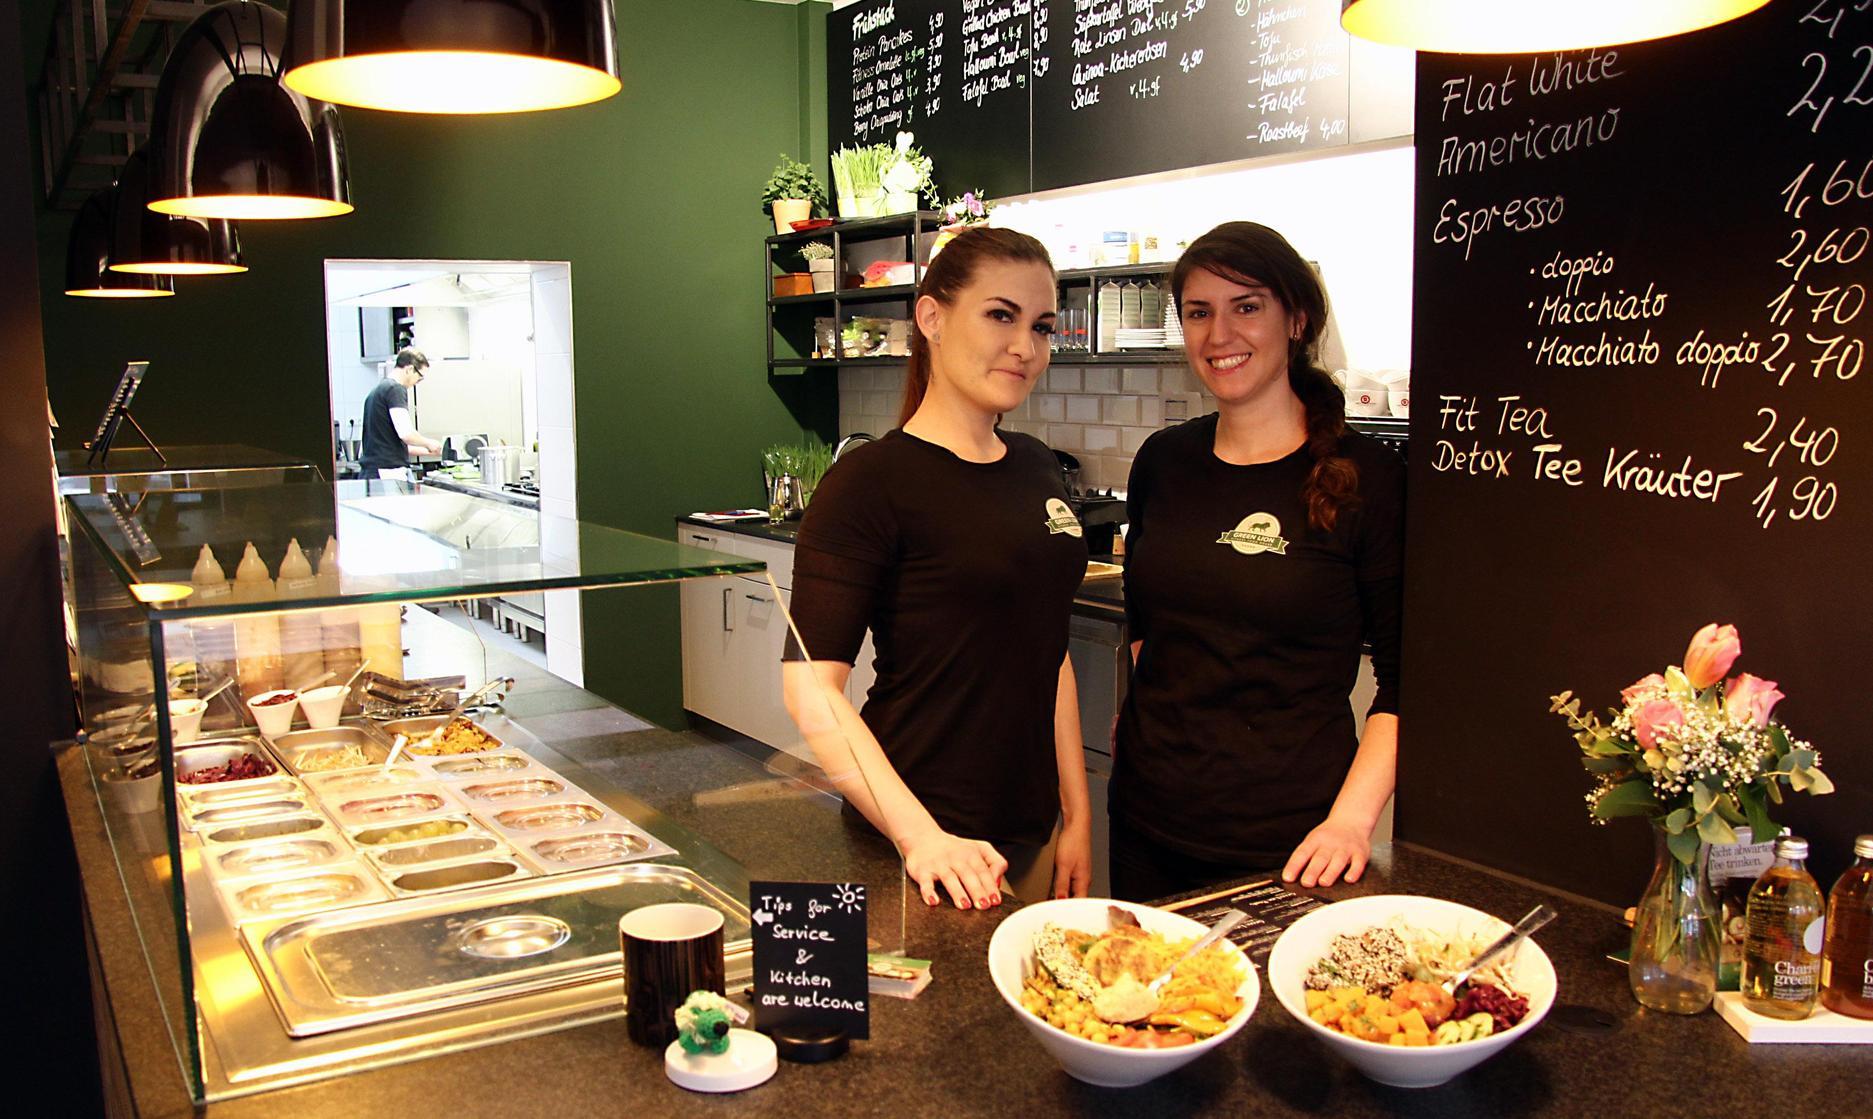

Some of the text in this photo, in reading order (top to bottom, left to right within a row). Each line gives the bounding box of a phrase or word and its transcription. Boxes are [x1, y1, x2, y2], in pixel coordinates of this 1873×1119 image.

[986, 7, 1011, 28] Chicken
[981, 27, 999, 48] Bowl
[1071, 38, 1092, 58] Rote
[1095, 27, 1126, 48] Linsen
[1258, 32, 1281, 53] Tofu
[1179, 48, 1204, 73] 4,90
[962, 77, 989, 108] Falafel
[1070, 84, 1100, 110] Salat
[1442, 48, 1626, 122] Flat White
[1258, 86, 1307, 115] Falafel
[1258, 116, 1346, 144] Roastbeef 4,00
[1437, 107, 1622, 177] Americano
[1432, 194, 1565, 262] Espresso
[1541, 226, 1870, 298] doppio 2,60
[1537, 282, 1866, 327] Macchiato 1,70
[1535, 329, 1865, 388] Macchiato doppio 2,70
[1438, 394, 1840, 469] Fit Tea 2,40
[1431, 440, 1838, 530] Detox Tee Kräuter 1,90
[1232, 532, 1257, 541] GREEN
[1257, 535, 1275, 544] LION
[761, 895, 832, 919] Tips for
[772, 923, 835, 942] Service
[795, 948, 814, 965] &
[769, 970, 832, 988] Kitchen
[1774, 974, 1813, 987] green
[762, 990, 865, 1012] are welcome
